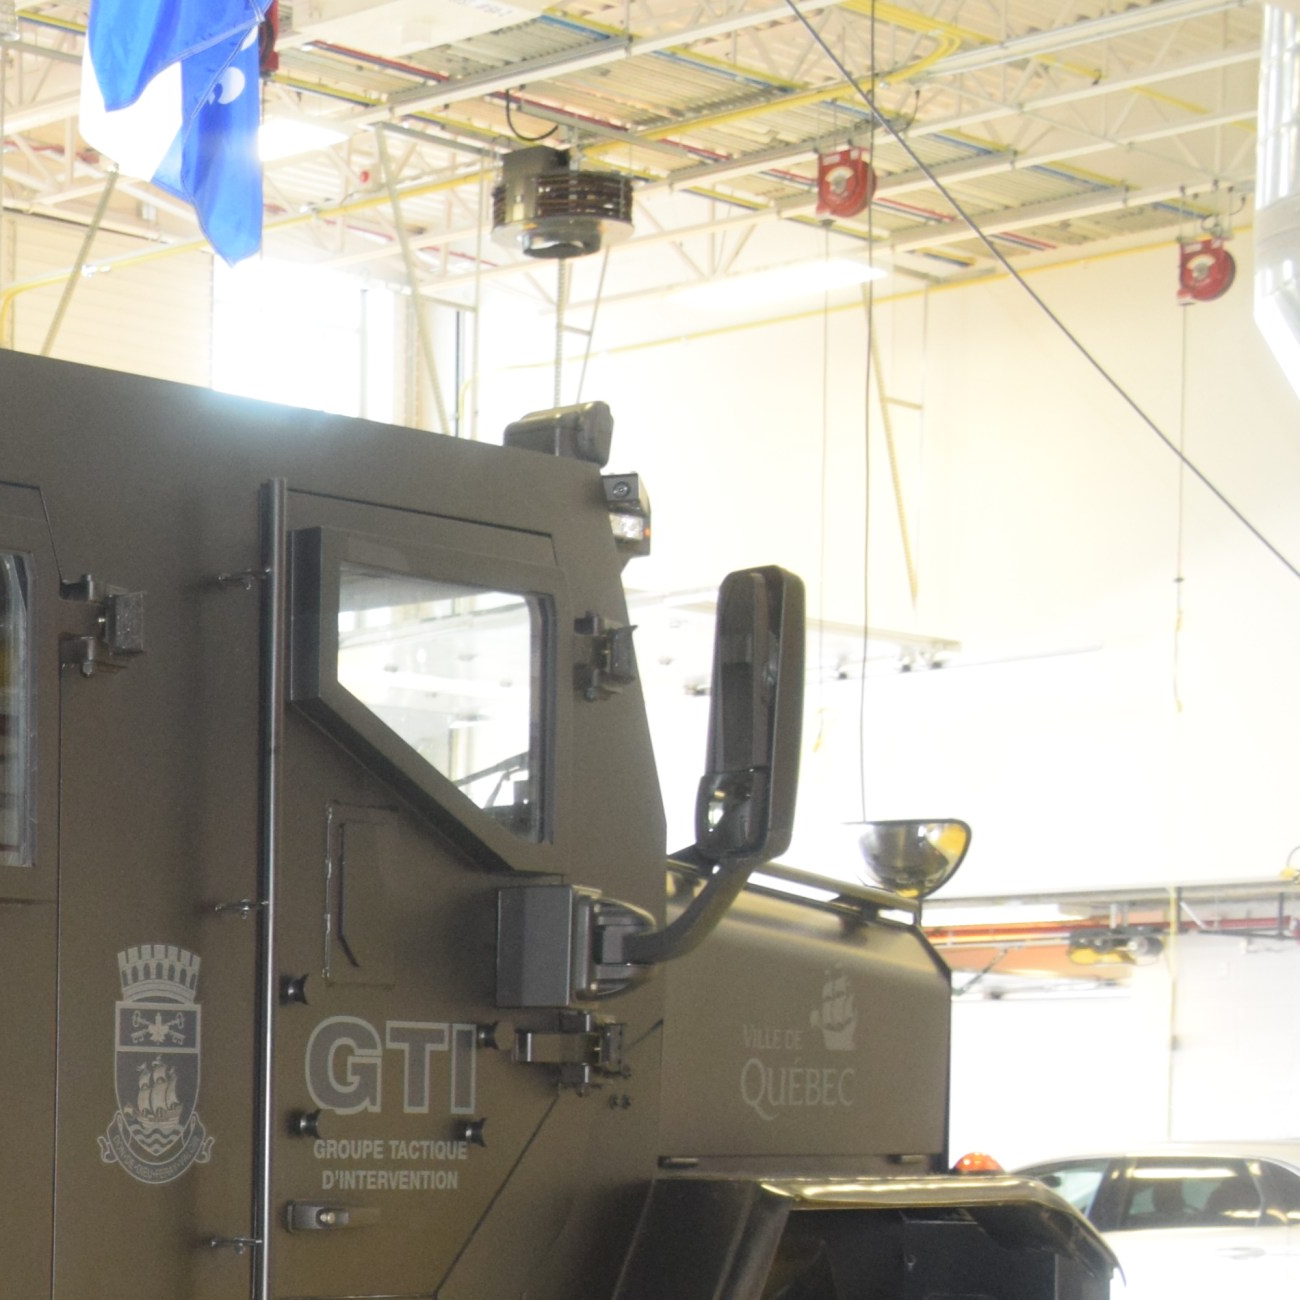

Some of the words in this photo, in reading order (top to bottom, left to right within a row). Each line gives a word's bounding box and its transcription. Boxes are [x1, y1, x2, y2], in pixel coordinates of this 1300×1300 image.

[743, 1023, 781, 1049] VILLE
[784, 1028, 804, 1050] DE
[304, 1015, 477, 1115] GTI
[740, 1056, 855, 1121] QUÉBEC
[312, 1138, 384, 1160] GROUPE
[388, 1139, 468, 1161] TACTIQUE
[321, 1169, 458, 1190] D'INTERVENTION
